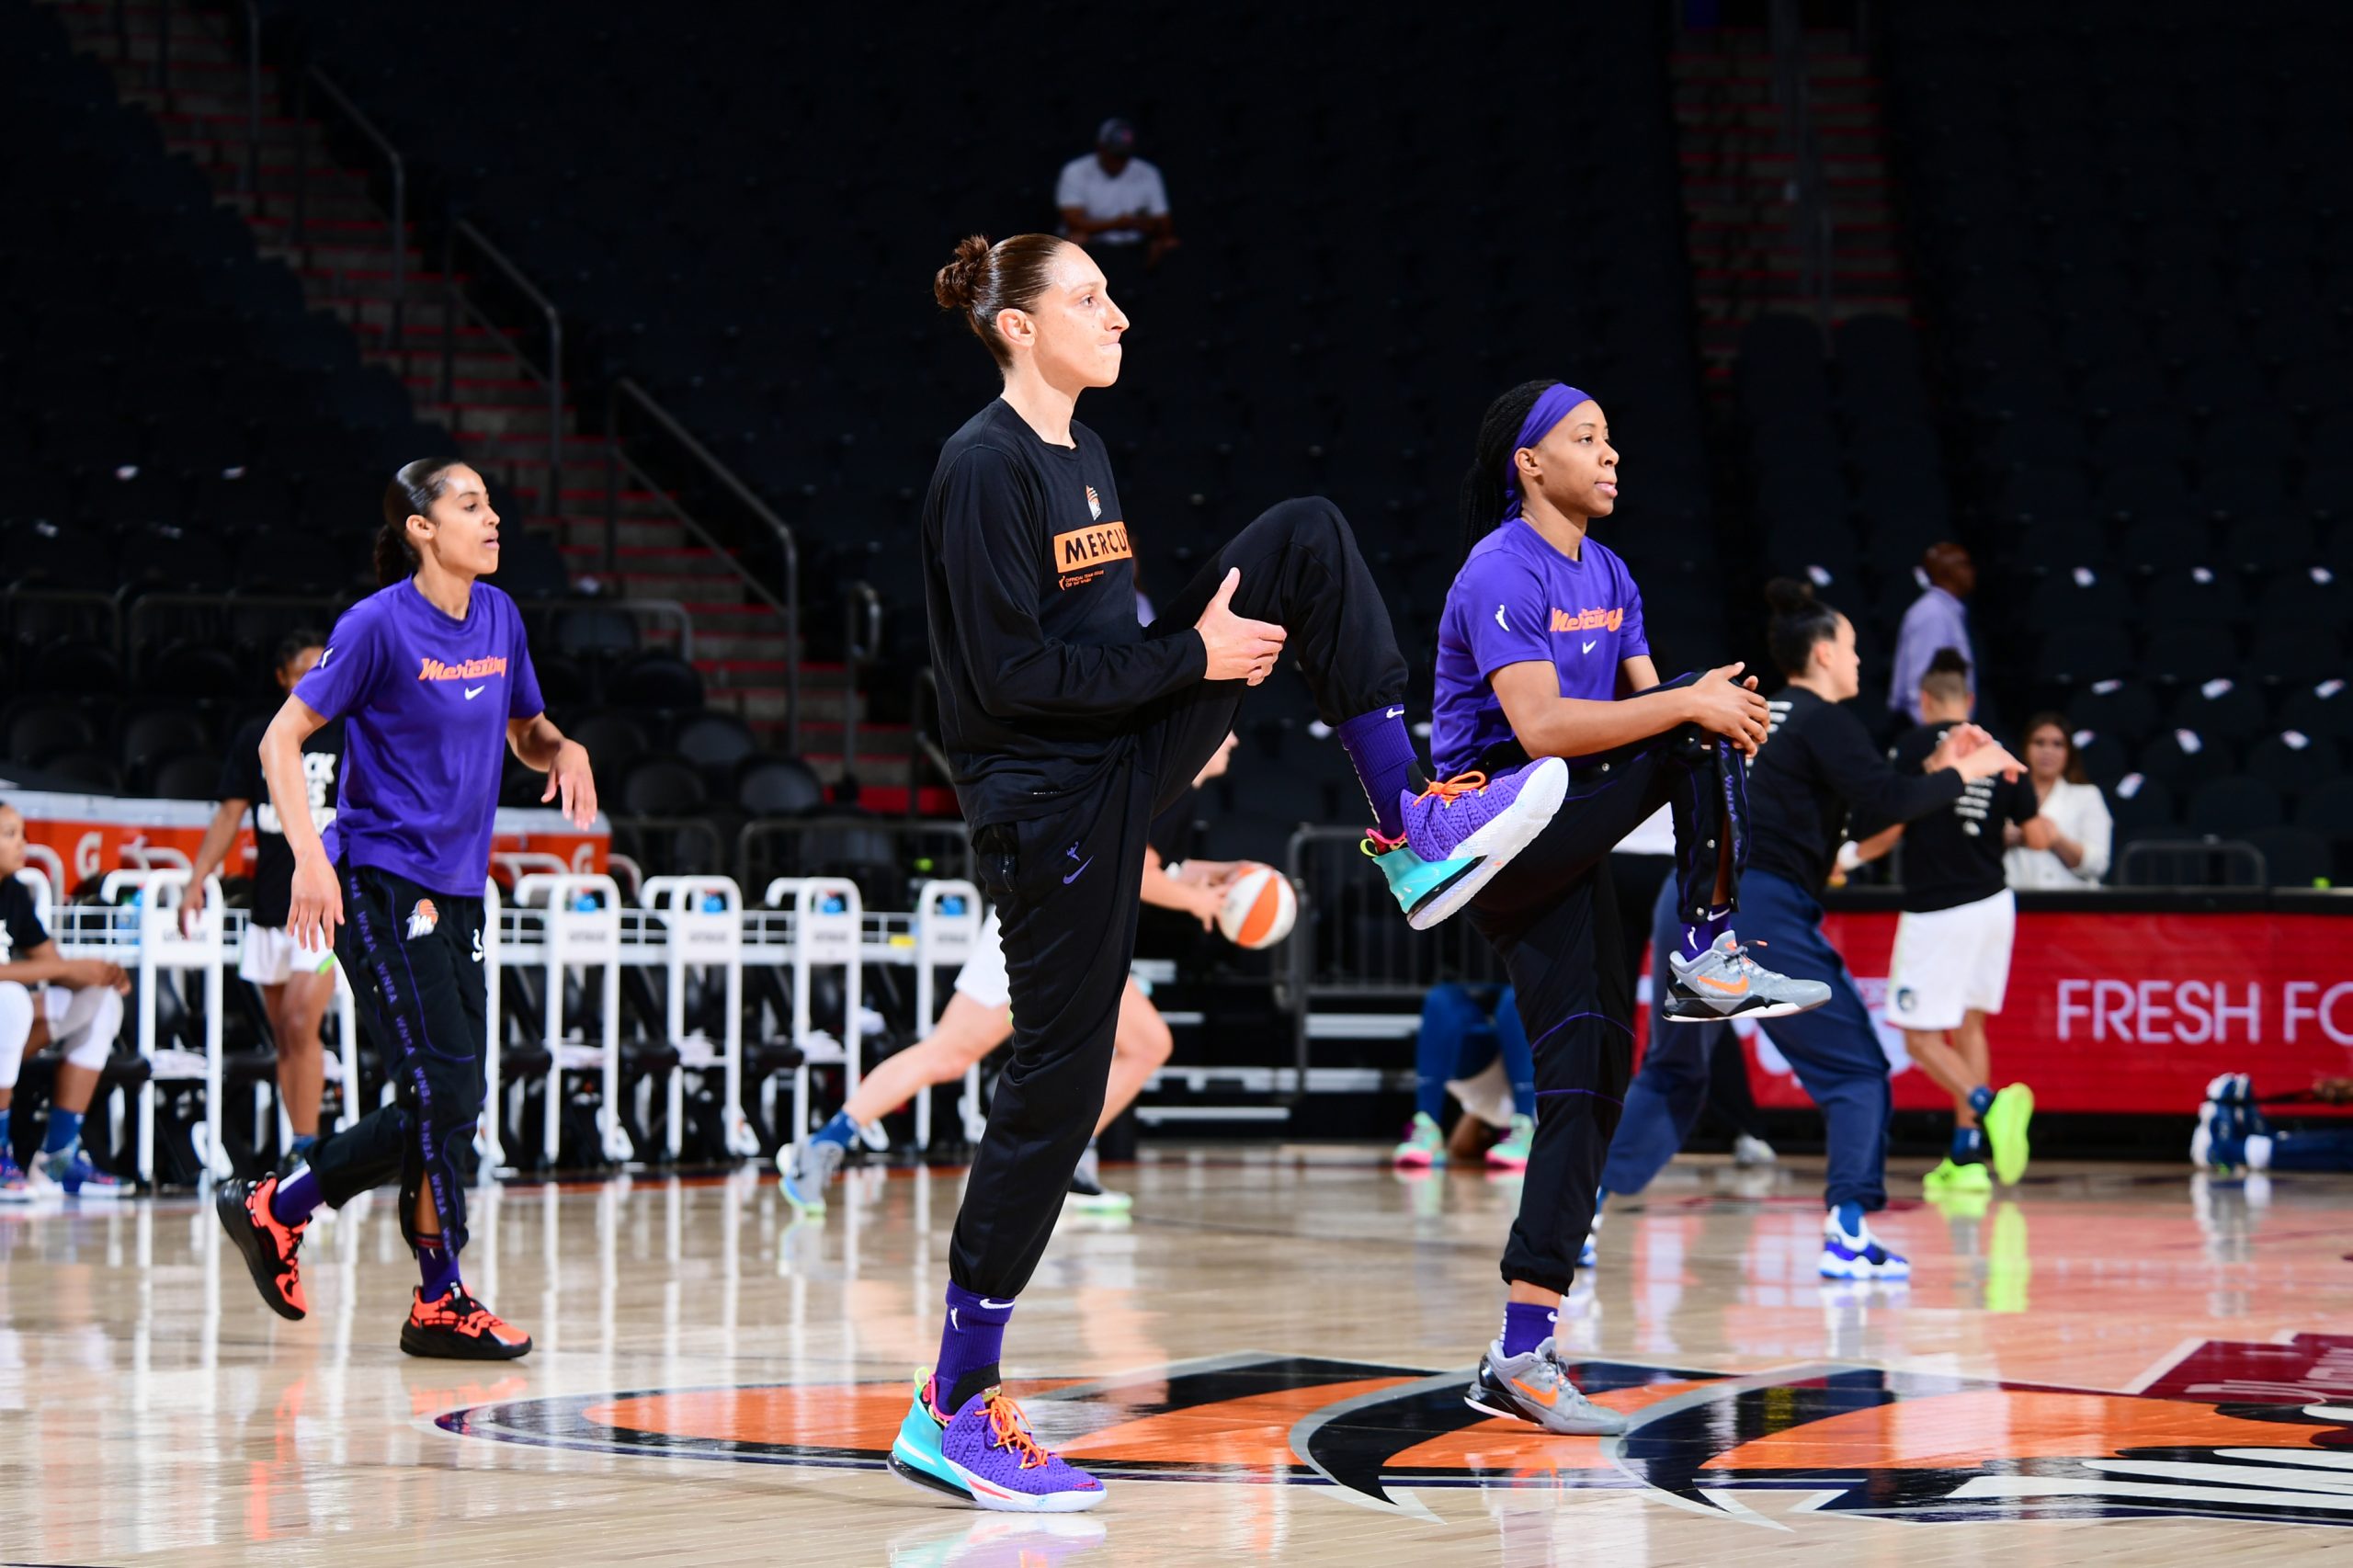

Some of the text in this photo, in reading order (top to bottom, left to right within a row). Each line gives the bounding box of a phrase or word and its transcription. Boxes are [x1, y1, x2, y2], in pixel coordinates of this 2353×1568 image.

[377, 961, 398, 1004] WNBA
[2057, 979, 2261, 1044] FRESH
[431, 1173, 448, 1215] WNBA
